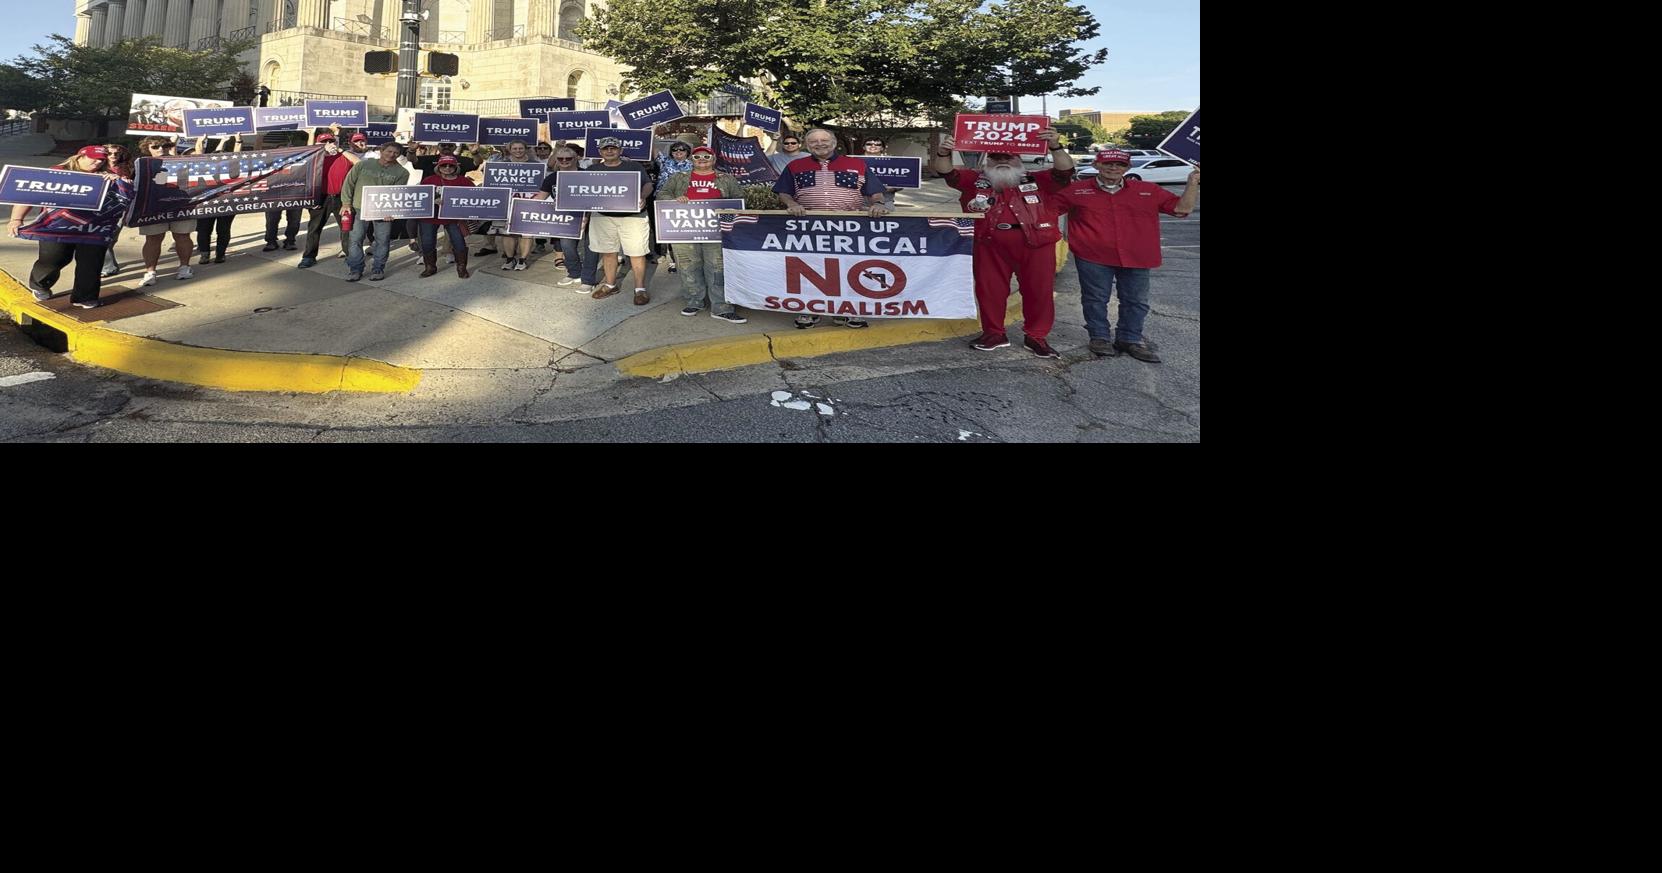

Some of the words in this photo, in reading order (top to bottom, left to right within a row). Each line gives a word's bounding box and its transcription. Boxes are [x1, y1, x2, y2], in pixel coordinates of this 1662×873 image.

[629, 102, 669, 118] TRUMP
[192, 116, 246, 125] TRUMP
[750, 111, 776, 122] TRUMP
[422, 122, 470, 130] TRUMP
[557, 120, 603, 128] TRUMP
[964, 121, 1040, 132] TRUMP
[973, 131, 1028, 141] 2024
[594, 138, 643, 147] TMP
[488, 168, 541, 176] TRUMP
[869, 166, 910, 175] RUMP
[15, 179, 94, 193] TRUMP
[688, 180, 717, 189] RUM
[567, 185, 629, 194] TRUMP
[368, 192, 429, 201] TRUMP
[374, 200, 422, 208] VANCE
[450, 197, 501, 206] TRUMP
[137, 211, 174, 223] MAKE
[177, 206, 234, 217] AMERICA
[236, 201, 274, 211] GREAT
[276, 199, 315, 208] AGAIN!
[661, 208, 721, 219] TRUM
[520, 211, 574, 223] TRUMP
[670, 219, 719, 228] VANC
[785, 219, 861, 233] STAND
[870, 221, 900, 233] UP
[761, 233, 928, 254] AMERICA!
[785, 255, 907, 299] NO
[764, 296, 929, 315] SOCIALISM
